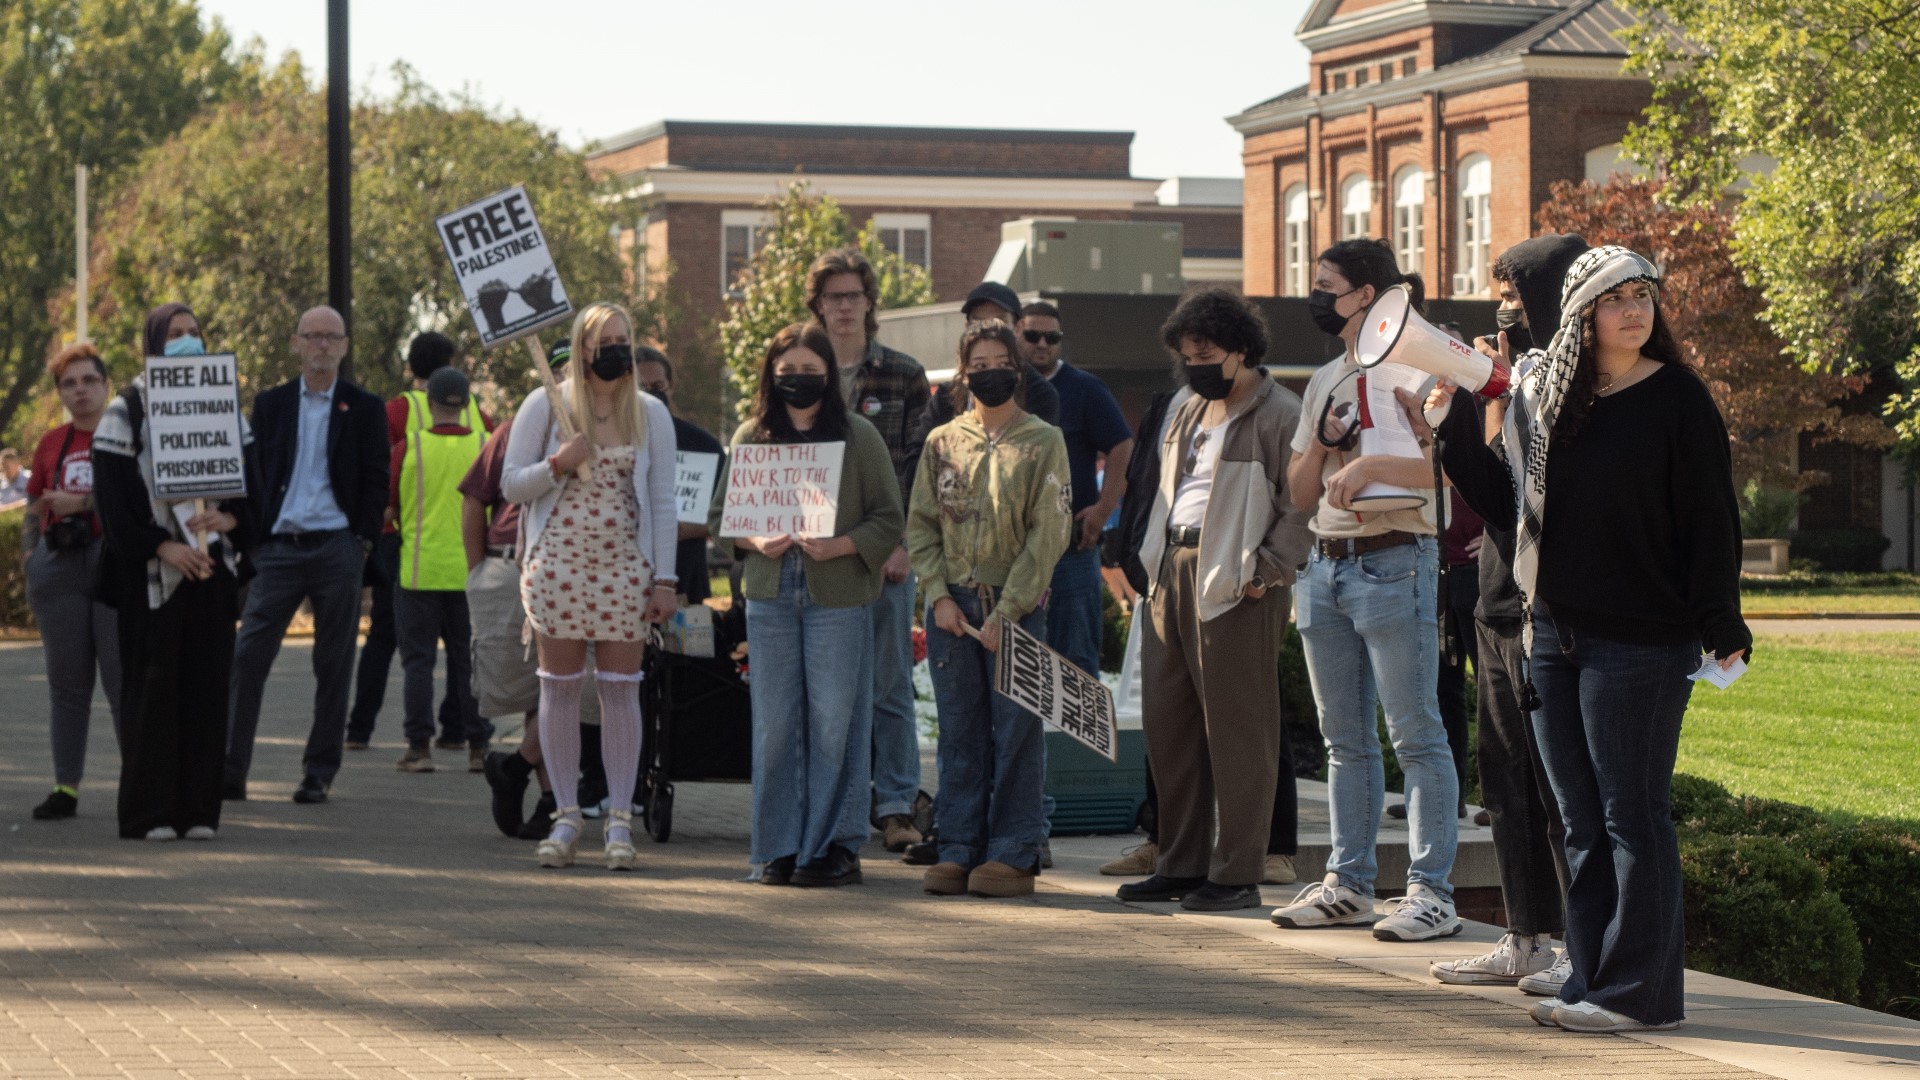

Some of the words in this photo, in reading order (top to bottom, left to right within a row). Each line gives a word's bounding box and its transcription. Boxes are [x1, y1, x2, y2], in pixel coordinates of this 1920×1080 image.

[444, 193, 533, 258] FREE
[457, 231, 541, 277] PALESTINE!
[1449, 340, 1471, 356] PYLE
[150, 366, 195, 388] FREE
[200, 364, 233, 387] ALL
[151, 400, 234, 417] PALESTINIAN
[160, 430, 231, 450] POLITICAL
[734, 447, 781, 464] FROM
[787, 445, 820, 462] THE
[156, 457, 239, 479] PRISONERS
[681, 471, 703, 481] THE
[732, 469, 779, 488] RIVER
[782, 469, 800, 484] TO
[805, 467, 830, 484] THE
[728, 491, 759, 508] SEA,
[762, 489, 829, 507] PALESTINE
[724, 515, 759, 532] SHALL
[766, 516, 782, 532] BE
[792, 514, 825, 534] FREE
[1012, 626, 1040, 709] NOW!
[1039, 644, 1054, 721] OCCUPATION
[1060, 662, 1081, 700] END
[1079, 673, 1096, 746] PALESTINE!
[1095, 685, 1108, 722] STAND
[1061, 697, 1081, 737] THE
[1096, 719, 1110, 755] WITH
